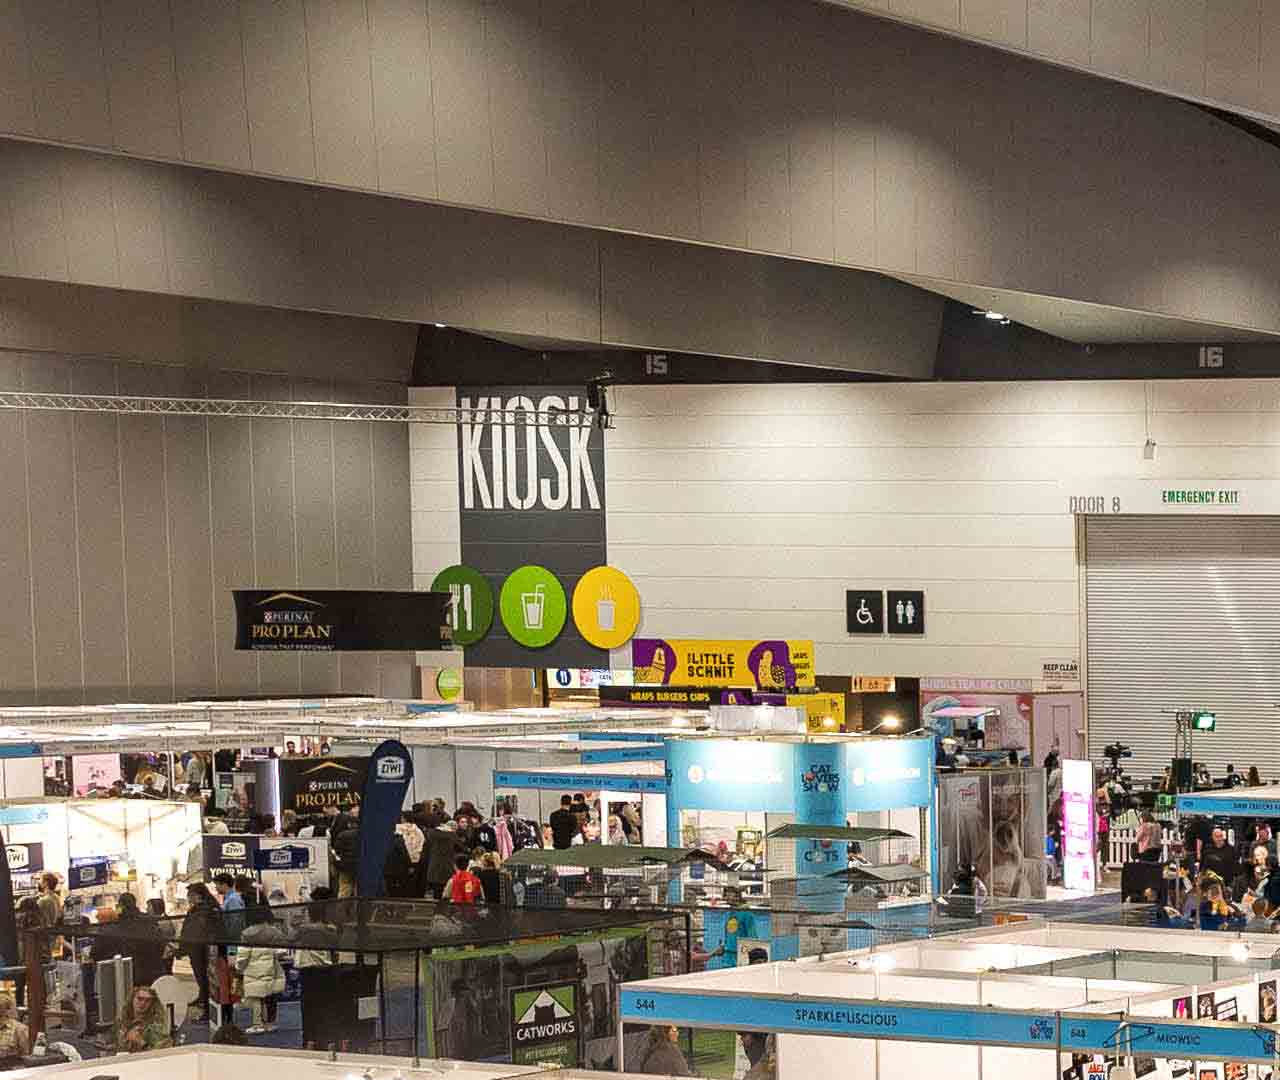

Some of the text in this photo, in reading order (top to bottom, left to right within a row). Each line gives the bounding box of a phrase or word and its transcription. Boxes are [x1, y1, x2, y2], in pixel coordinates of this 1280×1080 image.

[645, 354, 668, 375] 15
[1199, 346, 1224, 368] 16
[459, 395, 601, 511] KIOSK
[1162, 489, 1239, 504] EMERGENCY EXIT
[1069, 495, 1121, 514] DOOR 8
[251, 624, 331, 639] PRO PLAN
[691, 652, 735, 665] LITTLE
[687, 665, 736, 678] SCHNIT
[1059, 663, 1078, 672] CLEAR
[656, 692, 688, 701] BURGERS
[635, 999, 656, 1011] 544
[516, 1020, 576, 1041] CATWORKS
